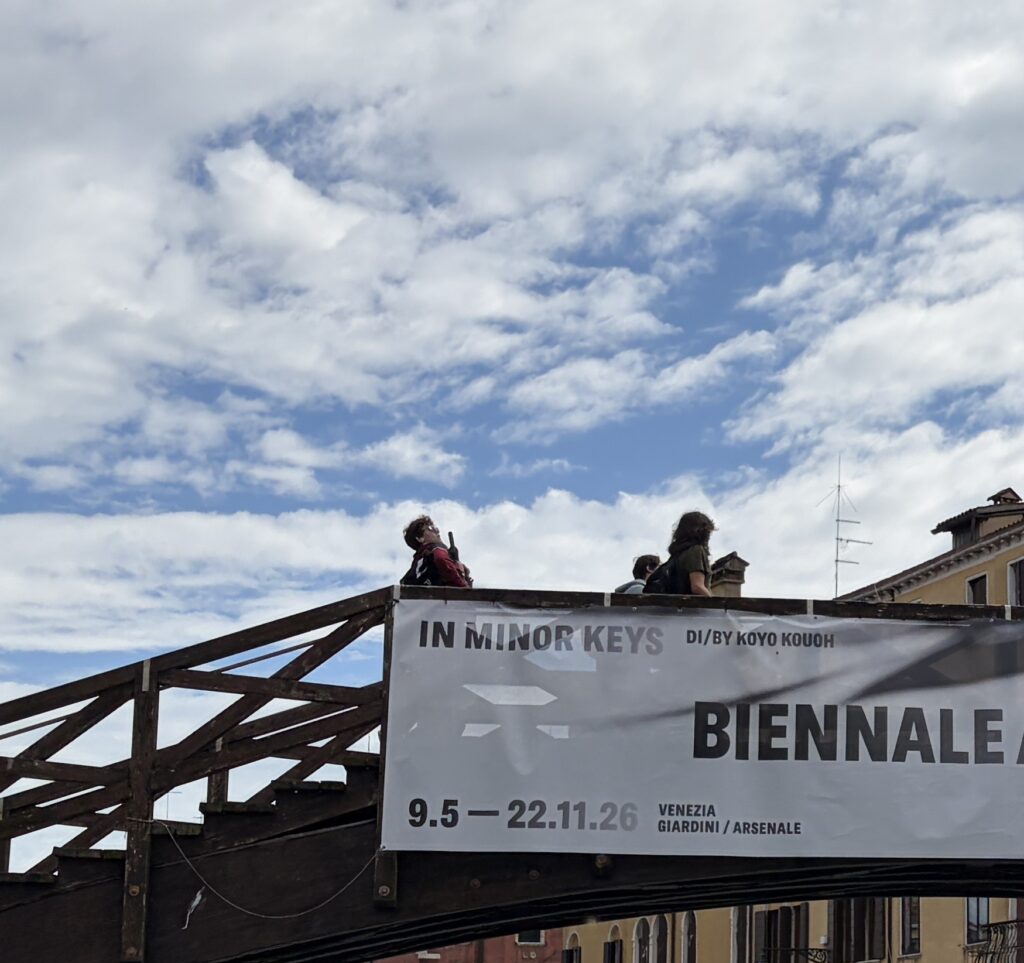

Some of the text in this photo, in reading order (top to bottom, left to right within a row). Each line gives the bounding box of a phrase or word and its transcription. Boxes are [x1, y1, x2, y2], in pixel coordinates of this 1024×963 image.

[419, 620, 665, 655] IN MINOR KEYS
[686, 629, 835, 648] DI/BY KOYO KOUOH
[693, 701, 1004, 764] BIENNALE
[408, 798, 460, 828] 9.5
[507, 799, 639, 831] 22.11.26
[658, 803, 716, 817] VENEZIA
[658, 820, 719, 833] GIARDINI
[732, 821, 802, 835] ARSENALE
